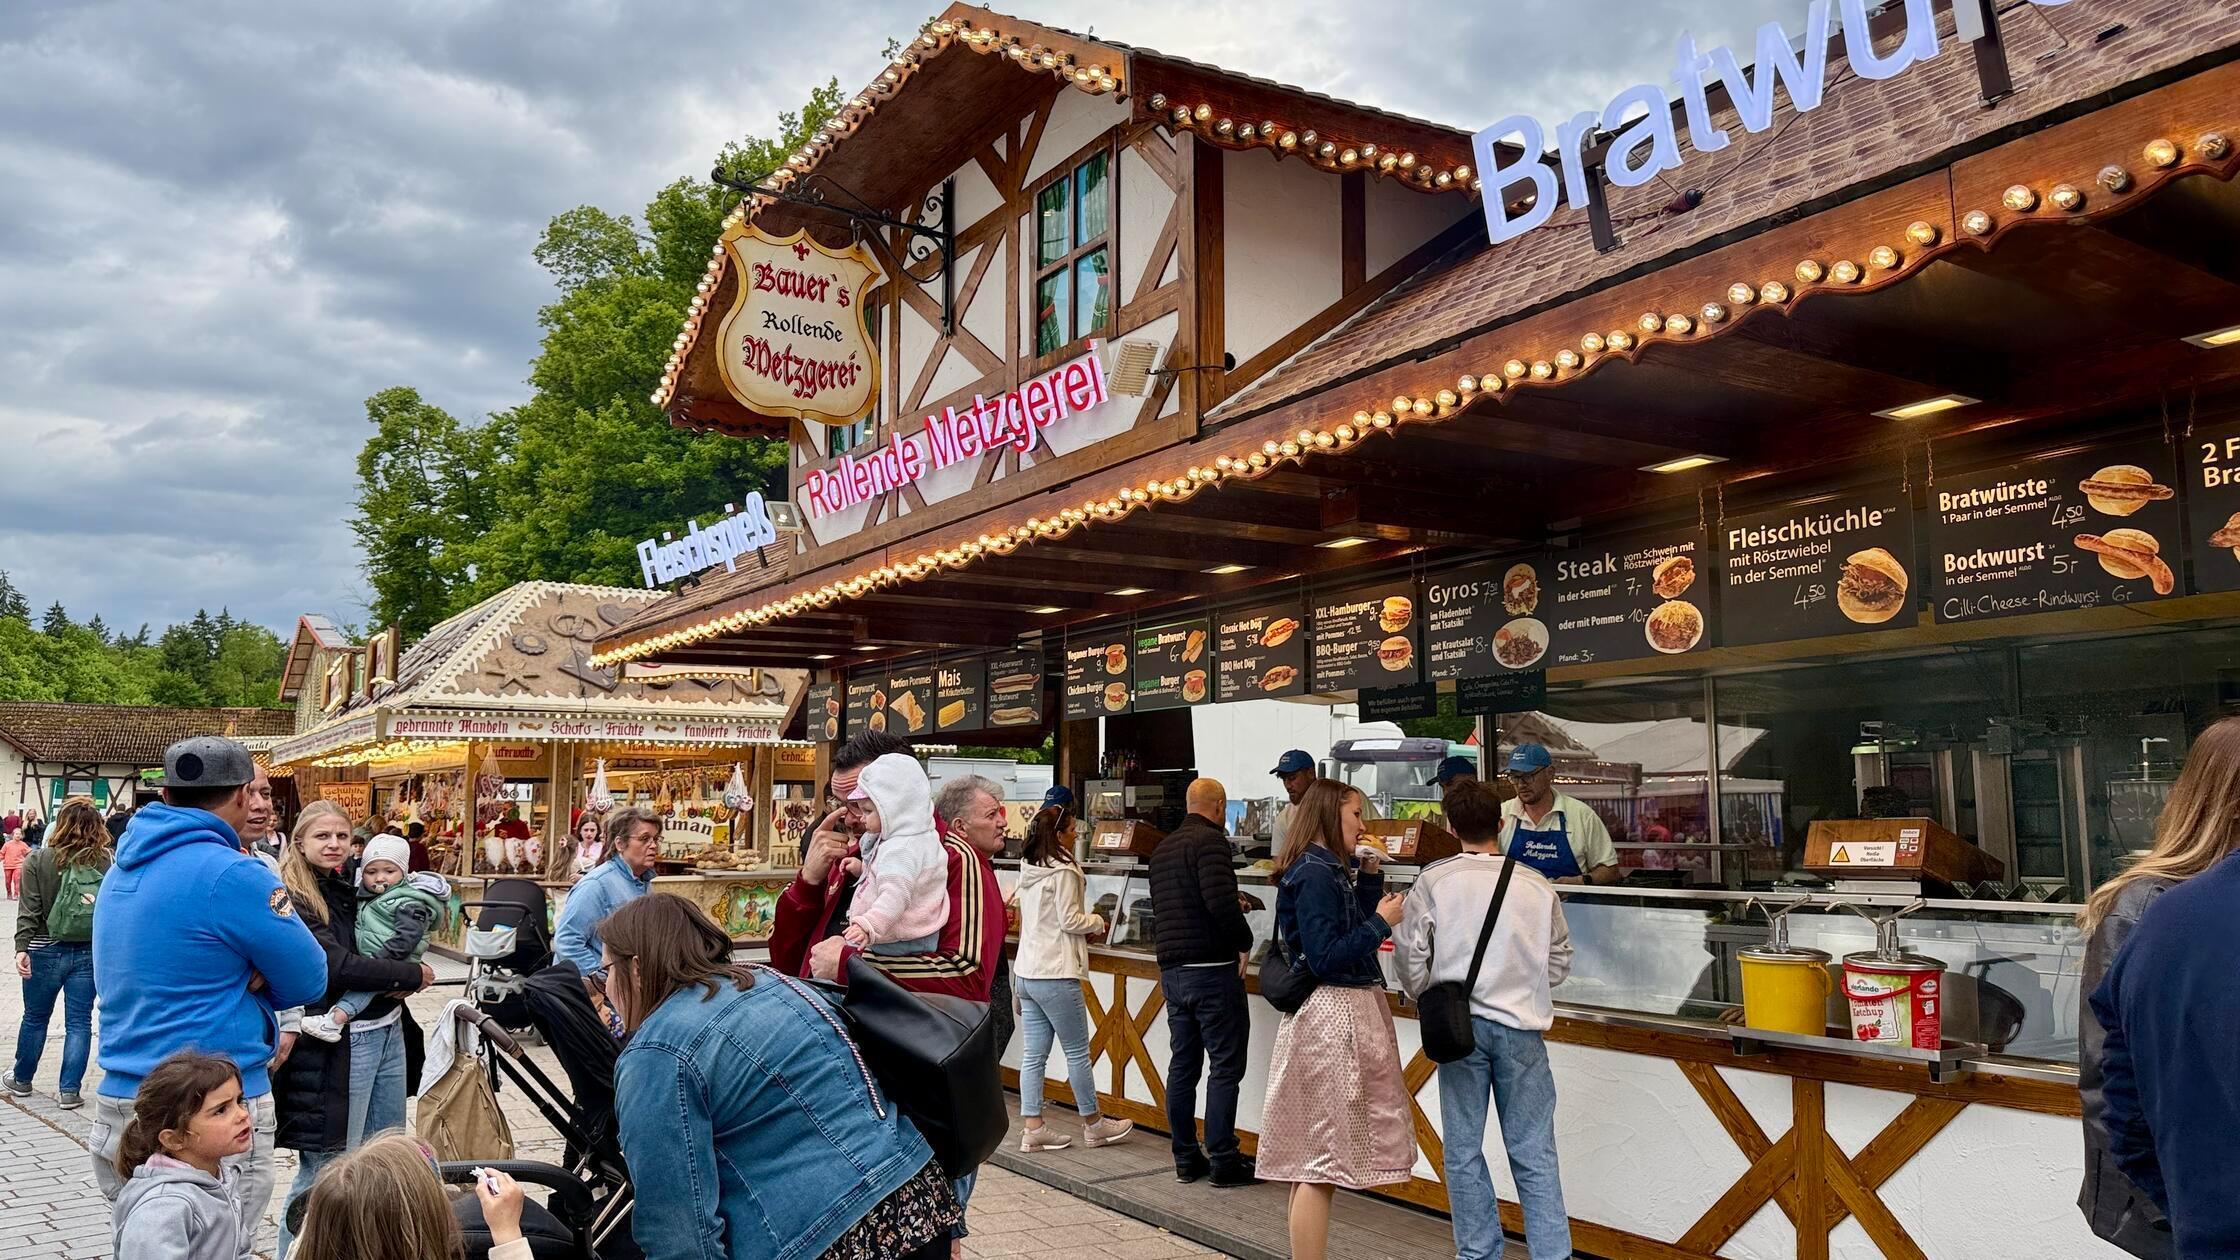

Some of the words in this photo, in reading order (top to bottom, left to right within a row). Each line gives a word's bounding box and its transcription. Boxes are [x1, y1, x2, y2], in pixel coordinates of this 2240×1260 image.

[1471, 0, 2078, 245] Bratwu
[761, 311, 843, 343] Rollende
[743, 335, 856, 399] Metzgerei
[806, 432, 926, 519] Rollende
[925, 339, 1110, 472] Metzgerei
[2201, 443, 2218, 464] 2
[1939, 478, 2048, 512] Bratwürste
[1942, 515, 1947, 525] 1
[1950, 511, 1971, 523] Paar
[1973, 508, 1983, 519] in
[1985, 505, 2002, 517] der
[2004, 499, 2047, 514] Semmel
[1728, 506, 1883, 550] Fleischküchle
[636, 491, 776, 588] Fleischspieß
[1557, 552, 1618, 581] Steak
[1624, 553, 1641, 563] vom
[1643, 544, 1678, 558] Schwein
[1679, 541, 1695, 552] mit
[1730, 553, 1751, 568] mit
[1754, 539, 1831, 565] Röstzwiebel
[1944, 541, 2045, 573] Bockwurst
[1730, 572, 1742, 586] in
[1745, 567, 1767, 584] der
[1769, 559, 1822, 580] Semmel
[1945, 575, 1955, 586] in
[1957, 572, 1974, 585] der
[1976, 568, 2017, 583] Semmel
[1429, 582, 1478, 607] Gyros
[1558, 593, 1566, 603] in
[1567, 590, 1579, 602] der
[1580, 585, 1611, 599] Semmel
[1315, 602, 1371, 619] XXL-Hamburger
[1430, 612, 1438, 621] im
[1439, 606, 1472, 620] Fladenbrot
[1220, 622, 1239, 634] Classic
[1239, 620, 1249, 631] Hot
[1250, 619, 1262, 631] Dog
[1430, 622, 1441, 631] mit
[1442, 619, 1464, 629] Tsatsiki
[1558, 619, 1575, 630] oder
[1577, 616, 1590, 628] mit
[1591, 613, 1624, 626] Pommes
[1158, 630, 1186, 645] Bratwurst
[1431, 642, 1441, 651] mit
[1442, 637, 1474, 650] Krautsalat
[1315, 642, 1358, 656] BBQ-Burger
[1432, 651, 1443, 661] und
[1443, 649, 1466, 660] Tsatsiki
[1233, 660, 1244, 670] Hot
[1244, 659, 1256, 671] Dog
[891, 678, 908, 688] Portion
[909, 675, 932, 686] Pommes
[938, 669, 961, 688] Mais
[394, 719, 454, 734] gebrannte
[458, 719, 508, 734] Mandeln
[605, 721, 644, 736] Früchte
[736, 725, 772, 739] Früchte
[781, 750, 816, 762] Erdnüss
[664, 817, 713, 836] tman
[1525, 841, 1557, 850] Rollende
